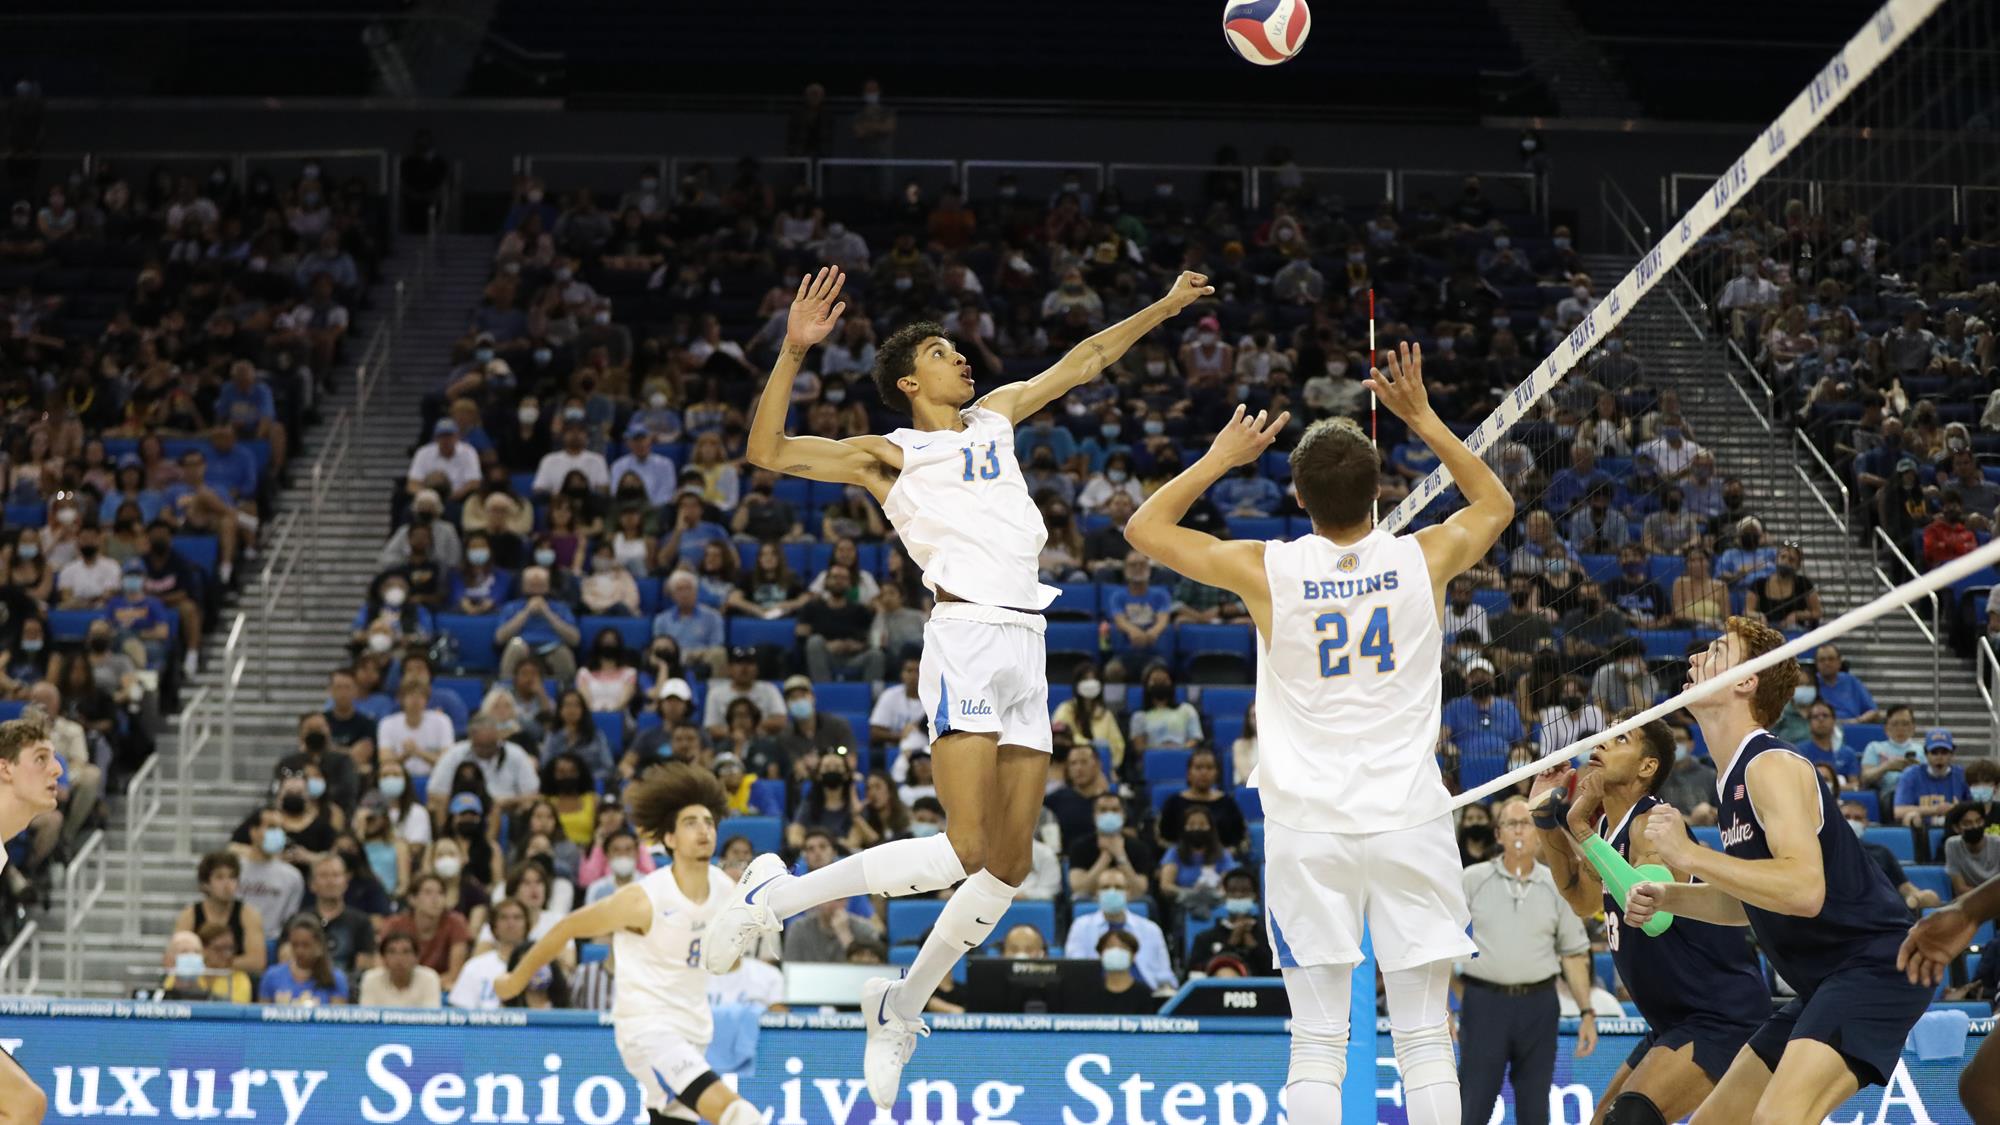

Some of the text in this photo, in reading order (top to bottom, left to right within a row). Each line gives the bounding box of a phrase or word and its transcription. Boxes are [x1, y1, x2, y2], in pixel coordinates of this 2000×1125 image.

[960, 440, 1001, 481] 13
[1303, 570, 1399, 600] BRUINS
[1314, 605, 1396, 679] 24
[960, 698, 993, 716] Ucla
[1223, 991, 1258, 1009] POSS
[50, 1003, 114, 1018] presented
[115, 1003, 134, 1019] by
[382, 1010, 449, 1025] presented
[450, 1010, 467, 1025] by
[787, 1013, 806, 1029] by
[932, 1016, 1199, 1033] PAULEY PAVILION presented by WESCOM
[1597, 1020, 1646, 1034] PAULEY
